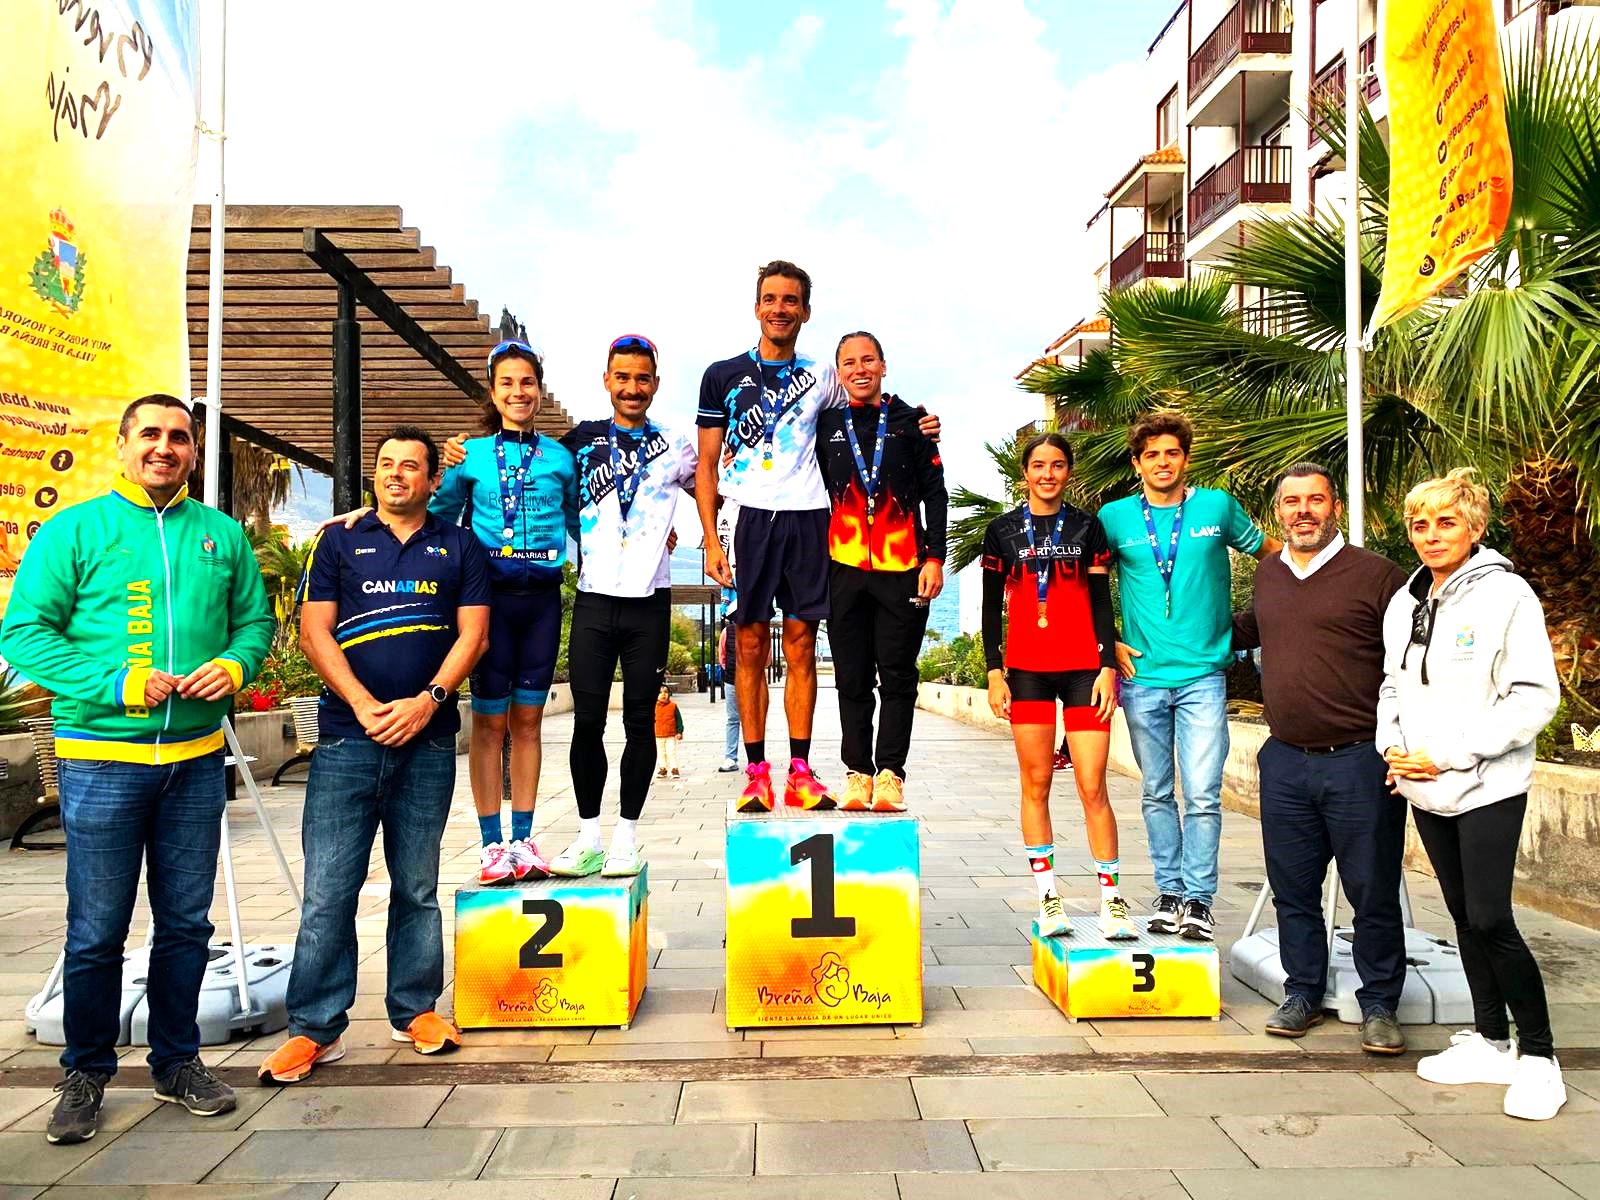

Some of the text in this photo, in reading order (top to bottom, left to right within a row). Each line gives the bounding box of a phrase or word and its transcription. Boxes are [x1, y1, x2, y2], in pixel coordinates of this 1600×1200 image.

[127, 579, 153, 635] BAJA
[361, 580, 439, 596] CANARIAS
[790, 833, 857, 939] 1
[519, 899, 565, 969] 2
[1132, 953, 1156, 993] 3
[498, 998, 586, 1015] Breña Baja
[757, 983, 892, 1010] Breña Baja
